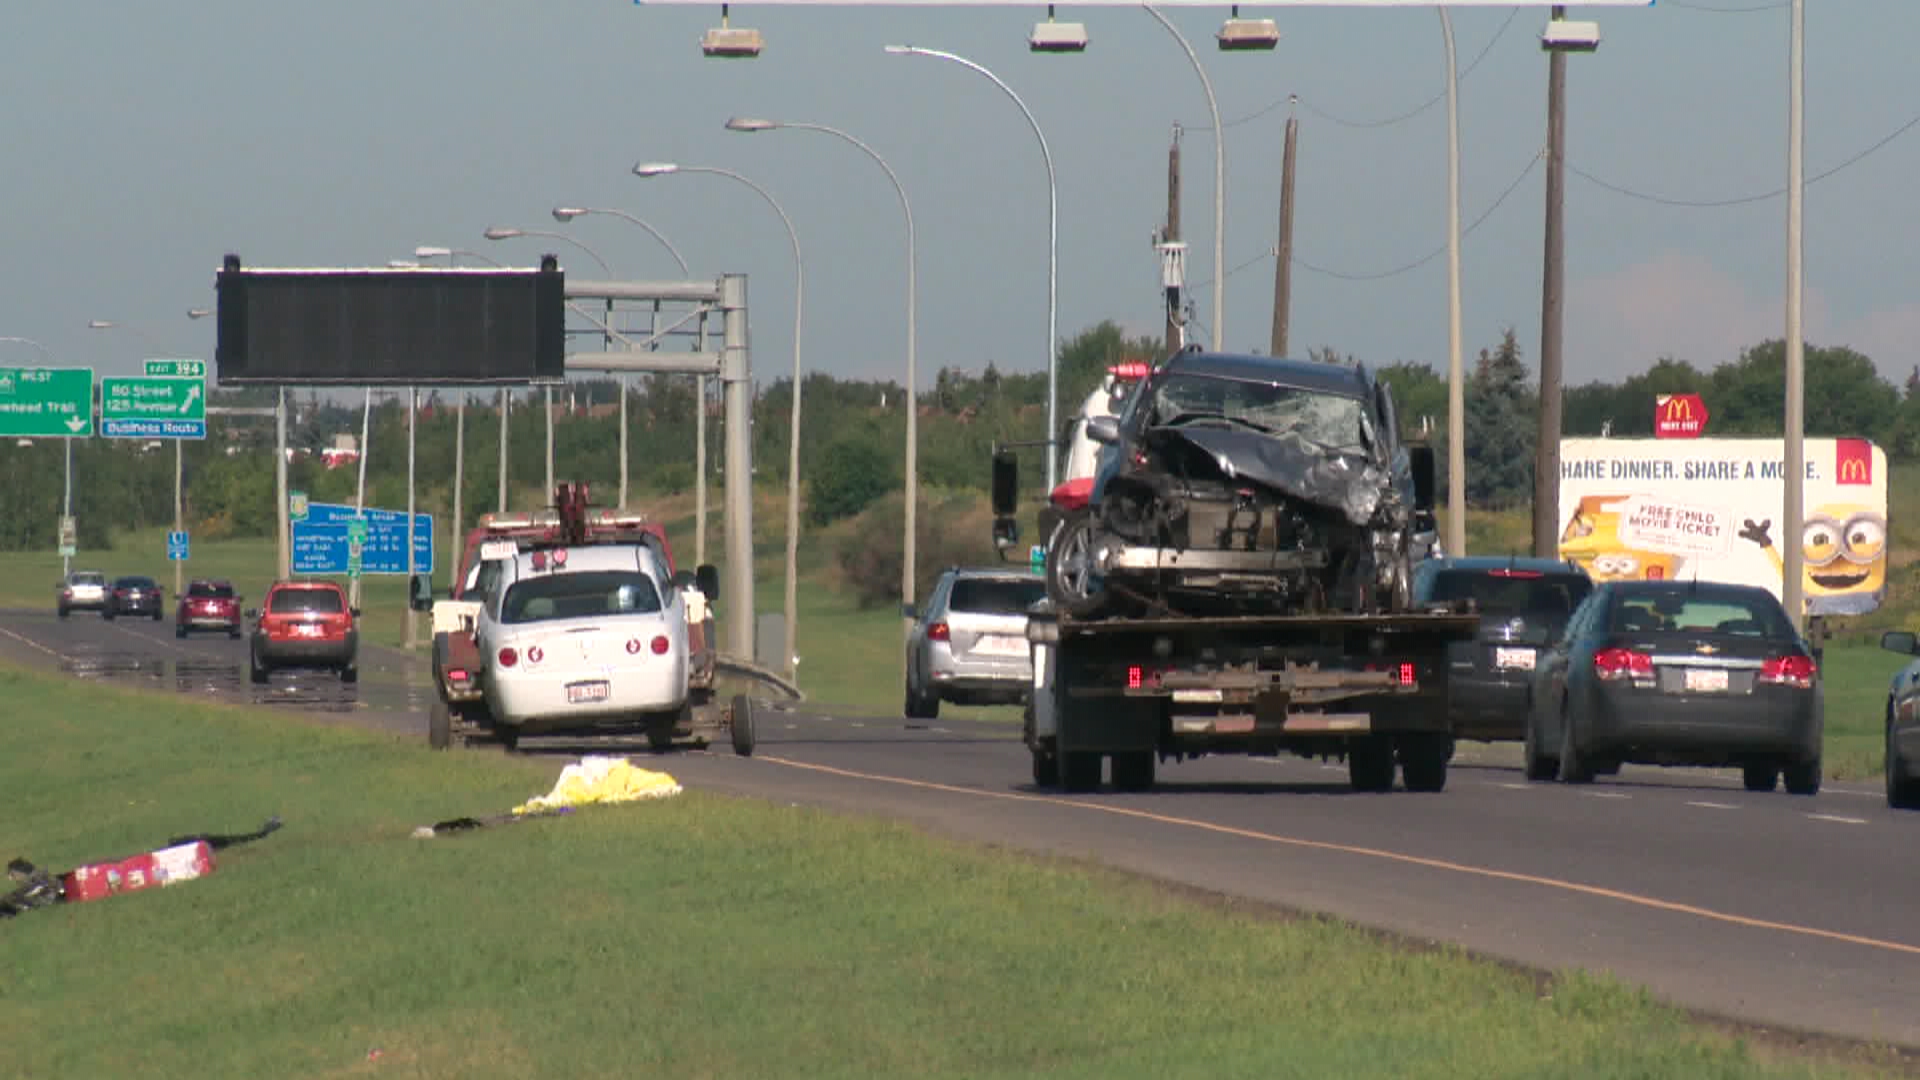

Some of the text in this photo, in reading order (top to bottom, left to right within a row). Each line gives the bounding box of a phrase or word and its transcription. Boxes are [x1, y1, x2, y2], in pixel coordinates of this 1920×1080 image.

[176, 362, 199, 375] 394
[133, 384, 173, 398] Street
[0, 401, 77, 413] whead Trail
[107, 422, 199, 433] Business Route
[1561, 459, 1821, 480] HARE DINNER. SHARE A MOE.
[1640, 504, 1715, 525] FREE CHILD
[1629, 516, 1721, 537] MOVIE TICKET
